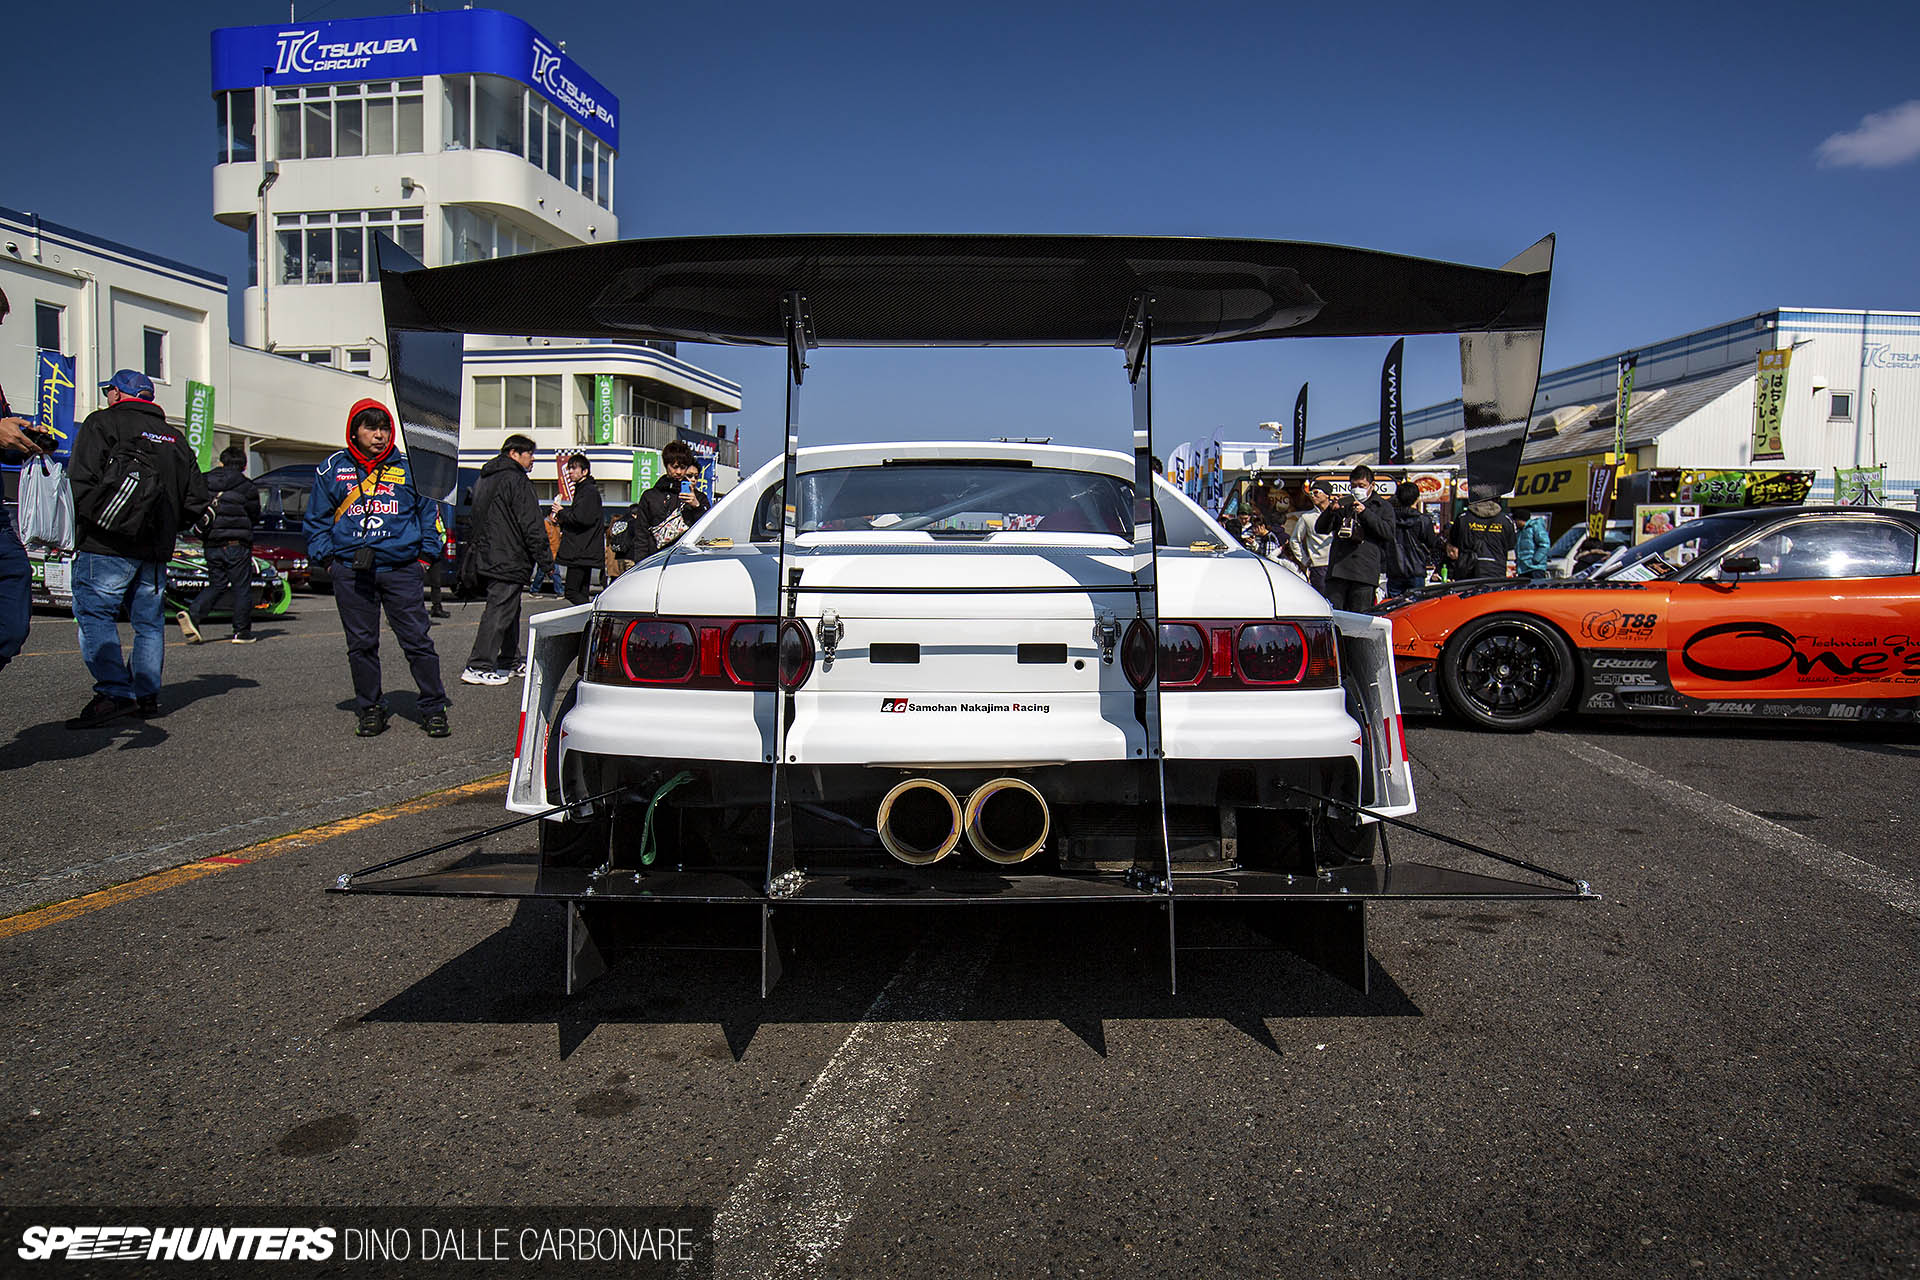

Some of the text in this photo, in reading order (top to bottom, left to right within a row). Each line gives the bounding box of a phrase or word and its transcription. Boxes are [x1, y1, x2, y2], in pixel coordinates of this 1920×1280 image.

[318, 37, 418, 58] TSUKUBA
[1388, 364, 1398, 459] YOKOHAMA
[188, 389, 206, 457] ODRIDE
[372, 499, 399, 515] Bull
[1621, 613, 1658, 628] T88
[1634, 693, 1675, 706] ENDLESS
[908, 703, 957, 712] Samohan
[960, 703, 1010, 714] Nakajima
[1012, 703, 1050, 714] Racing
[1827, 703, 1887, 719] Moty's
